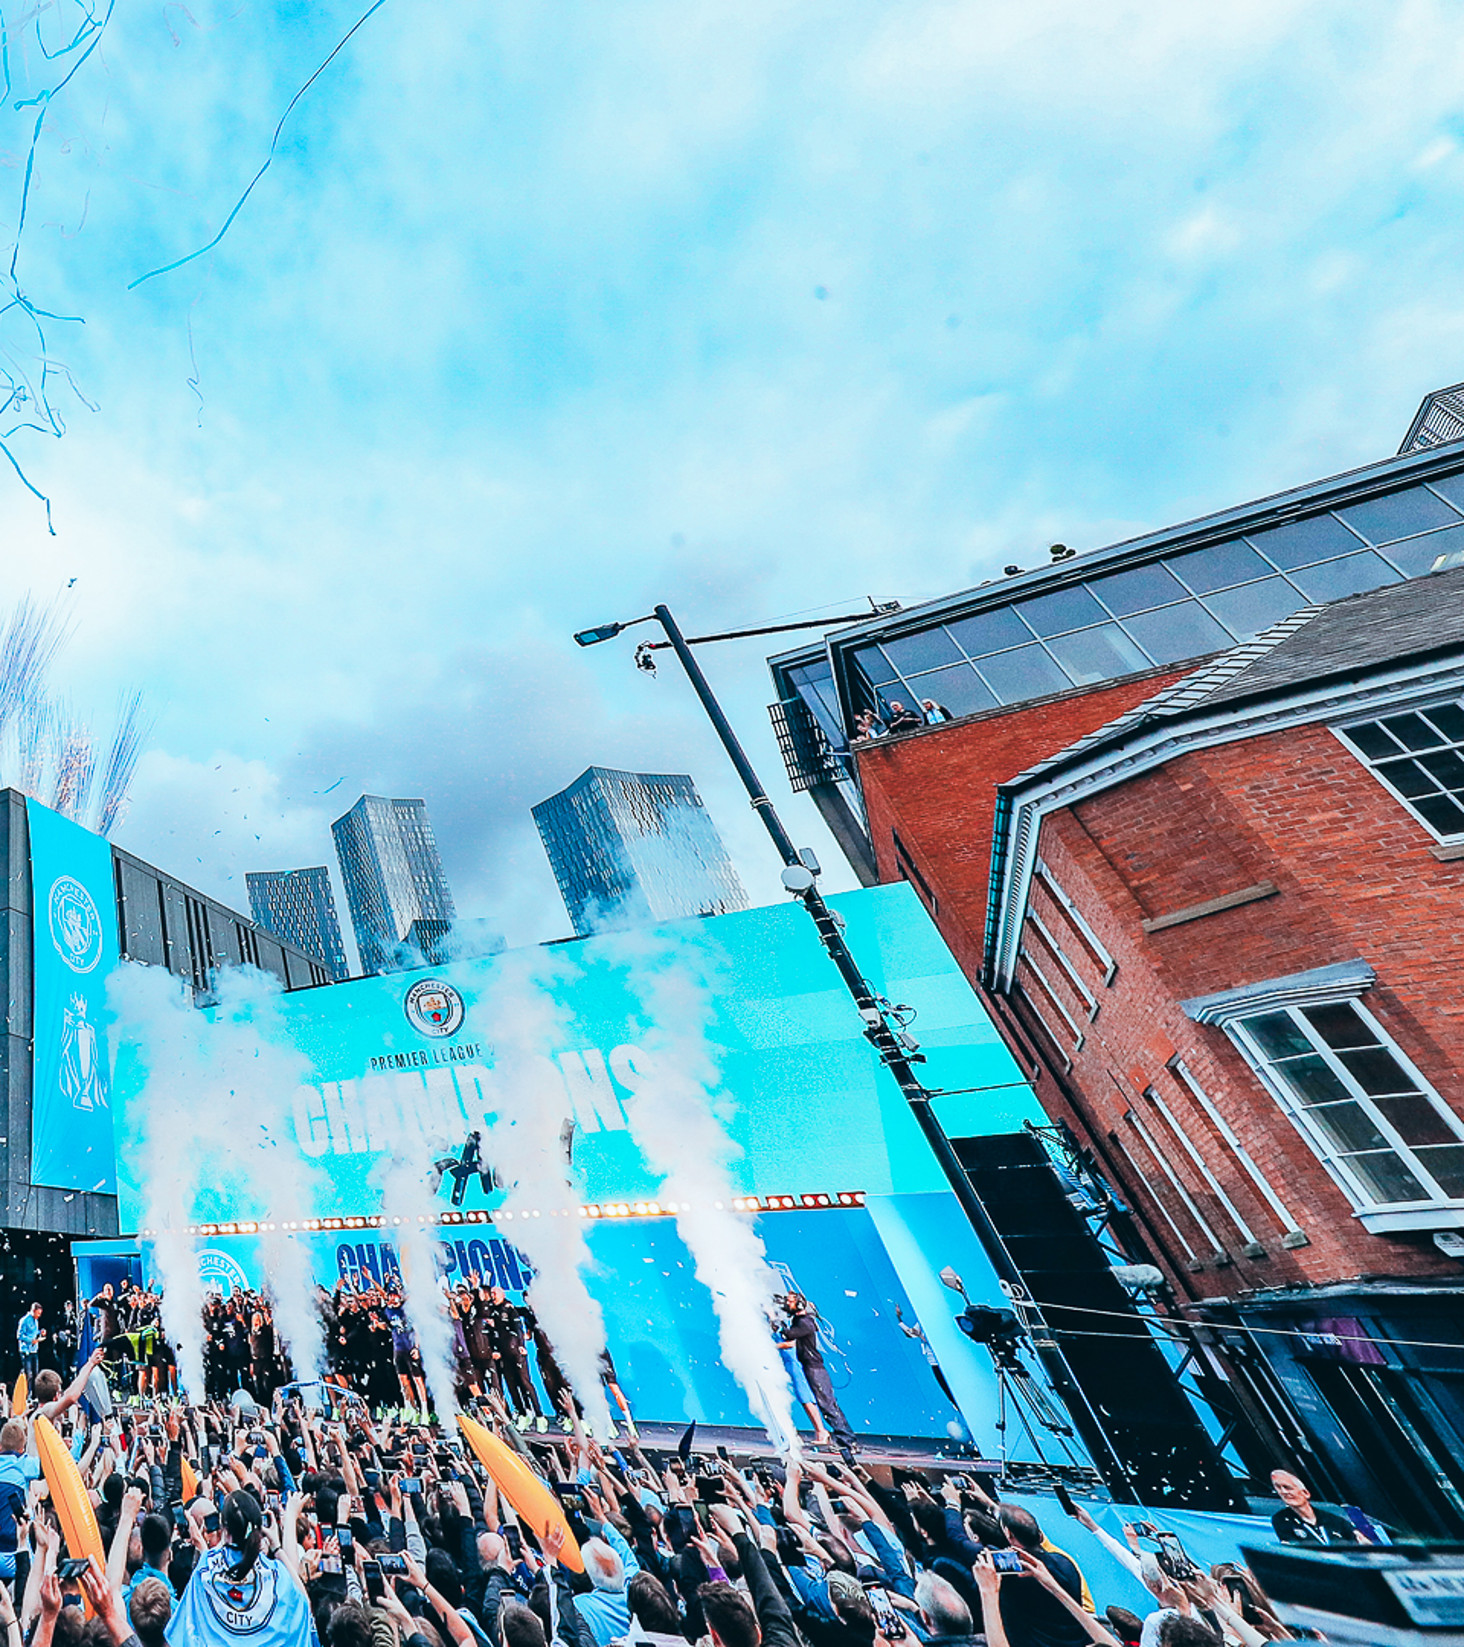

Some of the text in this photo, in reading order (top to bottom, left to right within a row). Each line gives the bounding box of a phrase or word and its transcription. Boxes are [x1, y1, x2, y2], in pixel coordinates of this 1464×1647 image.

[370, 1050, 429, 1071] PREMIER
[432, 1043, 483, 1063] LEAGUE
[293, 1044, 652, 1157] CHAMPNS
[337, 1239, 535, 1291] CHAPION
[226, 1611, 253, 1626] CITY
